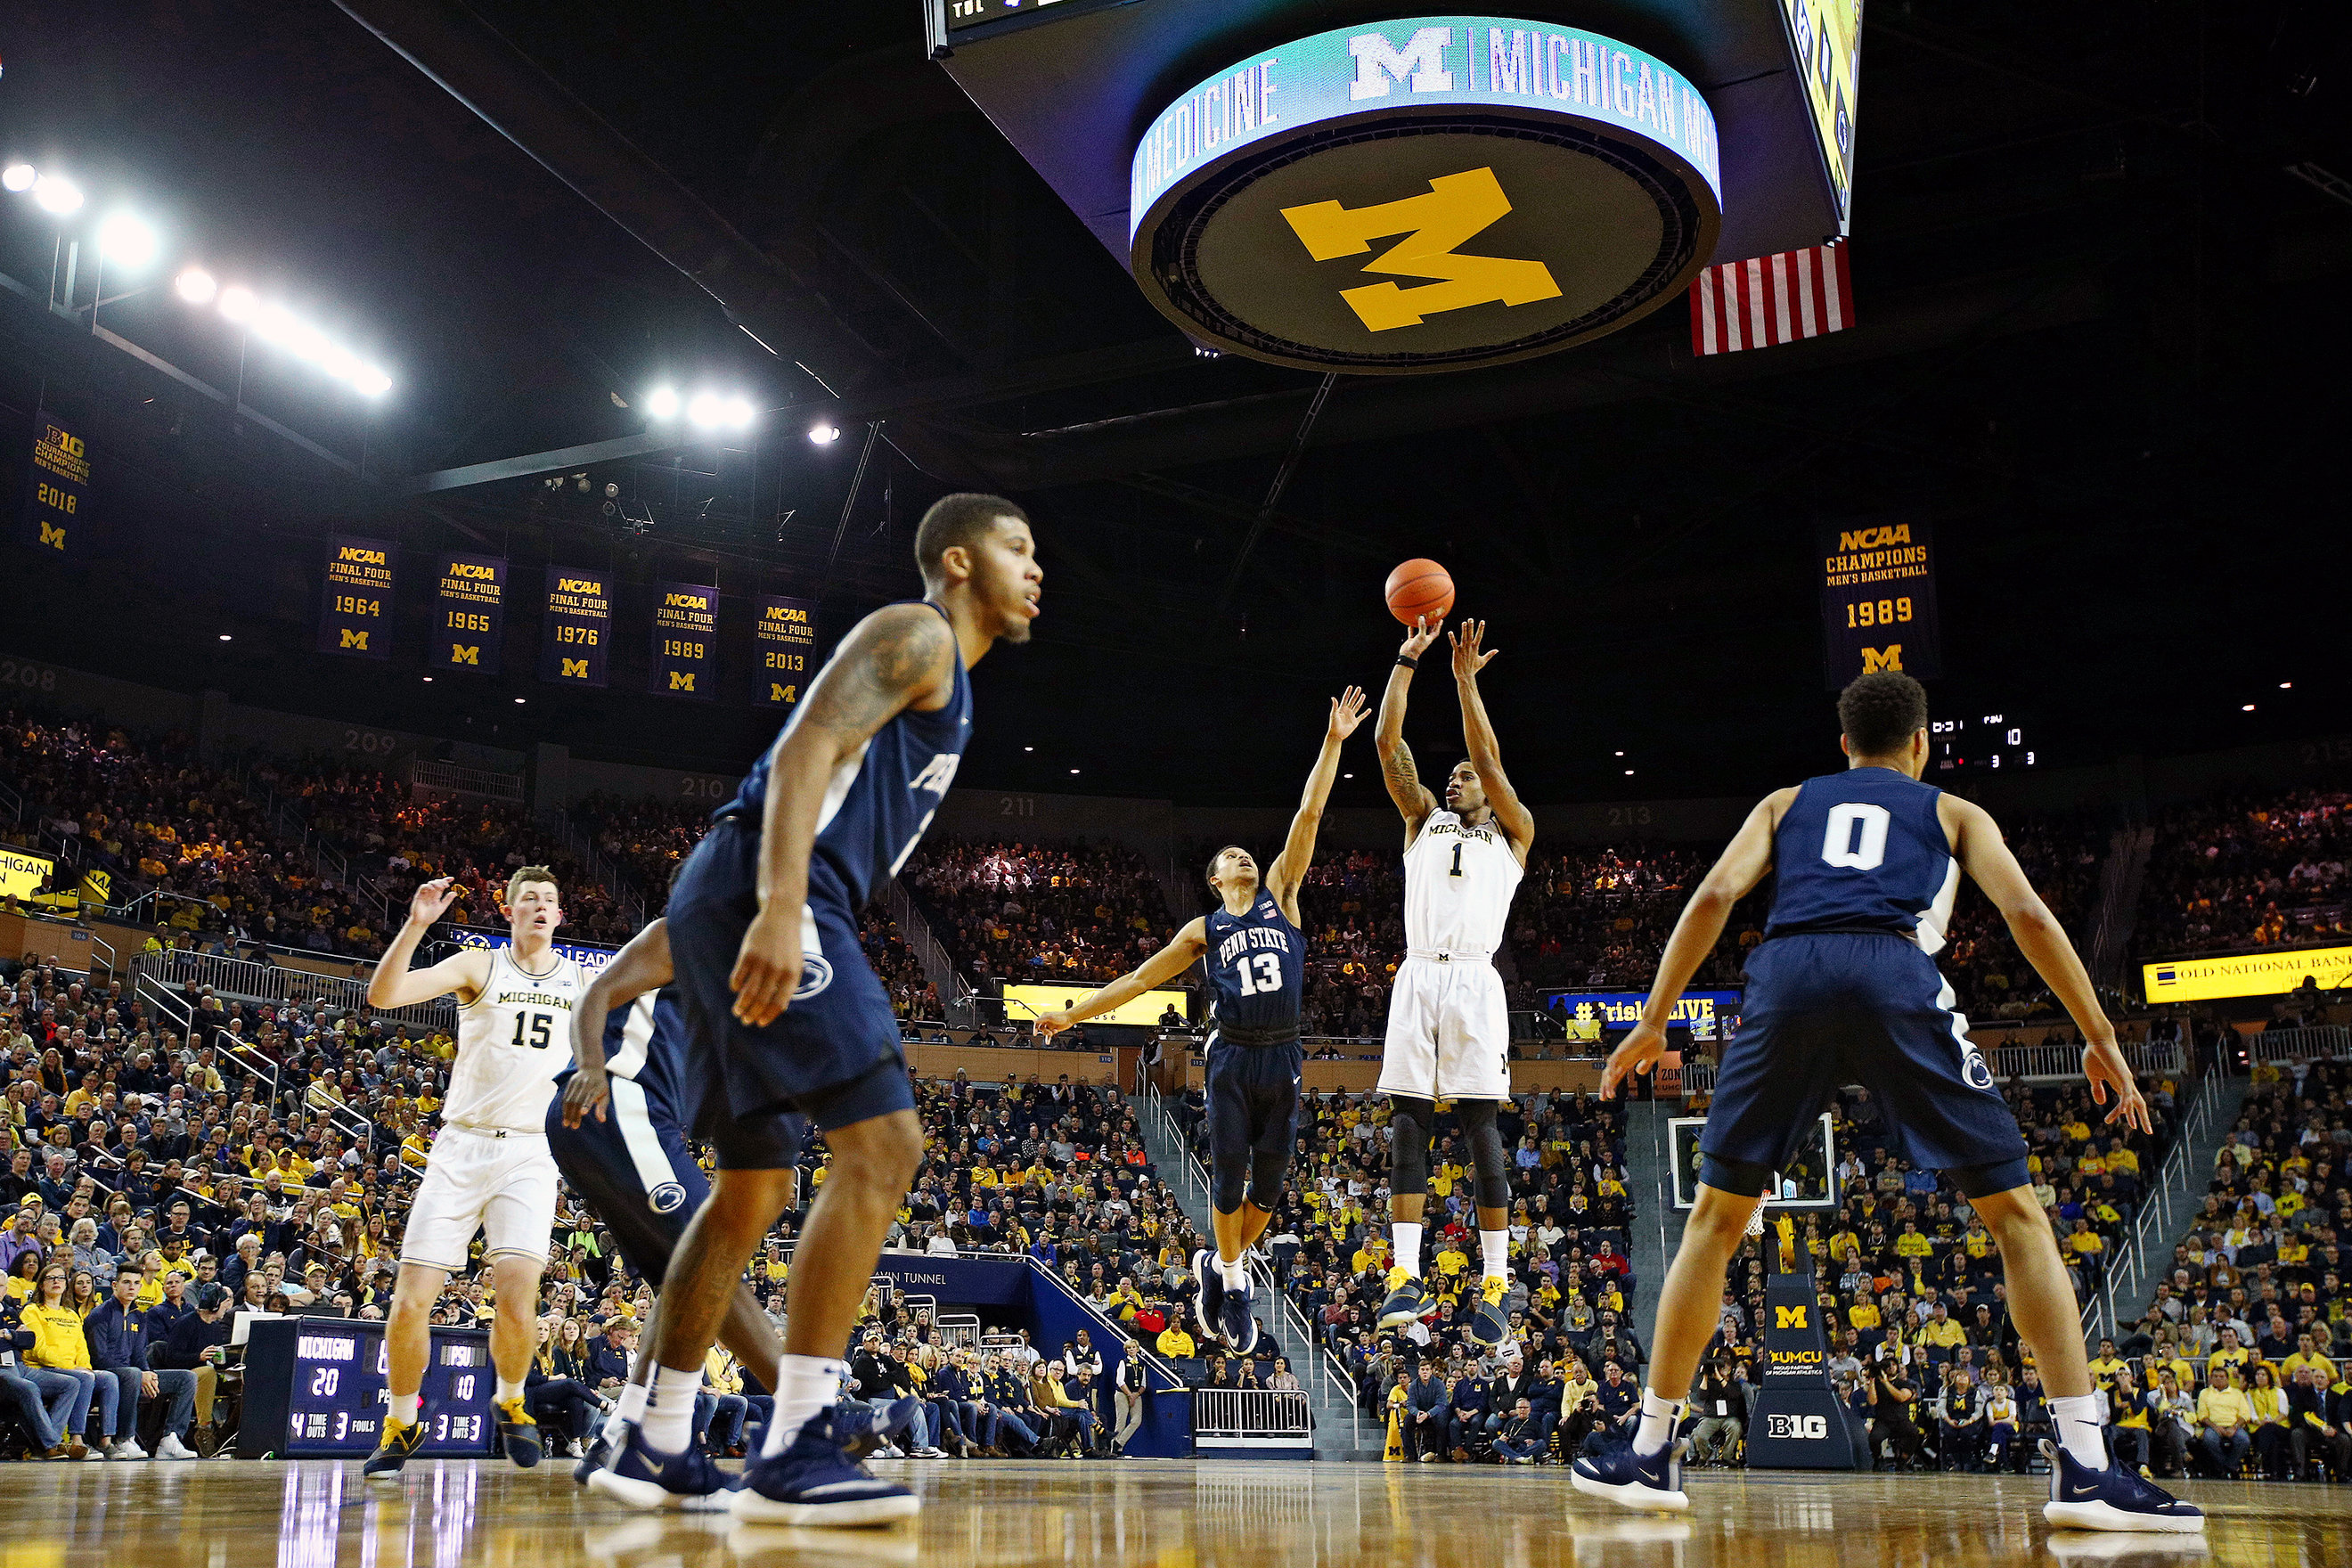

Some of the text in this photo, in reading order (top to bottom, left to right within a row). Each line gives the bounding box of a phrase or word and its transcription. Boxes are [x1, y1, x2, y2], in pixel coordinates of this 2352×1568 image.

[1348, 27, 1453, 102] M
[1489, 28, 1676, 140] MICHIGAN
[1146, 58, 1279, 200] MEDICINE
[1279, 166, 1563, 332] M
[36, 446, 89, 478] CHAMPIONS
[37, 439, 91, 468] TOURNAMENT
[34, 456, 87, 486] MEN'S BASKETBALL
[38, 482, 77, 514] 2018
[40, 521, 66, 551] M
[1839, 523, 1911, 551] NCAA
[339, 546, 385, 565] NCAA
[1825, 545, 1926, 573] CHAMPIONS
[329, 574, 391, 589] MEN'S BASKETBALL
[330, 562, 392, 581] FINAL FOUR
[449, 562, 494, 581] NCAA
[1826, 564, 1927, 587] MEN'S BASKETBALL
[439, 590, 500, 604] MEN'S BASKETBALL
[440, 578, 501, 596] FINAL FOUR
[558, 578, 601, 595] NCAA
[336, 595, 380, 617] 1964
[549, 605, 608, 618] MEN'S BASKETBALL
[550, 593, 608, 610] FINAL FOUR
[665, 593, 707, 610] NCAA
[1847, 596, 1913, 628] 1989
[447, 611, 490, 632] 1965
[657, 608, 714, 624] FINAL FOUR
[766, 607, 807, 623] NCAA
[556, 625, 599, 646] 1976
[657, 619, 714, 633] MEN'S BASKETBALL
[758, 620, 813, 637] FINAL FOUR
[339, 628, 369, 650] M
[757, 632, 813, 645] MEN'S BASKETBALL
[452, 643, 479, 666] M
[664, 640, 704, 659] 1989
[1861, 643, 1903, 675] M
[561, 657, 589, 679] M
[766, 651, 804, 672] 2013
[1, 660, 56, 691] 208
[669, 671, 695, 691] M
[771, 682, 796, 703] M
[344, 730, 396, 755] 209
[2006, 728, 2021, 746] 10
[1992, 755, 2000, 768] 3
[2027, 751, 2035, 765] 3
[682, 777, 724, 798] 210
[1000, 796, 1034, 817] 211
[1608, 805, 1652, 827] 213
[1428, 823, 1493, 845] MICHIGAN
[1821, 803, 1891, 871] 0
[1450, 842, 1463, 878] 1
[1219, 927, 1290, 969] PENN STATE
[1439, 953, 1450, 961] M
[1236, 951, 1283, 997] 13
[2180, 968, 2215, 979] OLD
[2220, 959, 2303, 976] NATIONAL
[498, 992, 572, 1012] MICHIGAN
[511, 1010, 553, 1049] 15
[1662, 1068, 1681, 1081] ZON
[903, 1272, 946, 1285] TUNNEL
[1776, 1305, 1808, 1328] M
[297, 1335, 355, 1361] MICHIGAN
[1779, 1350, 1823, 1363] UMCU
[312, 1367, 339, 1397] 20
[456, 1374, 476, 1401] 10
[291, 1412, 305, 1438] 4
[308, 1413, 328, 1426] TIME
[333, 1411, 349, 1441] 3
[352, 1420, 375, 1433] FOULS
[435, 1413, 449, 1441] 3
[453, 1416, 470, 1427] TIME
[469, 1414, 482, 1441] 3
[306, 1425, 327, 1439] OUTS
[452, 1427, 470, 1439] OUTS
[1388, 1446, 1401, 1456] M
